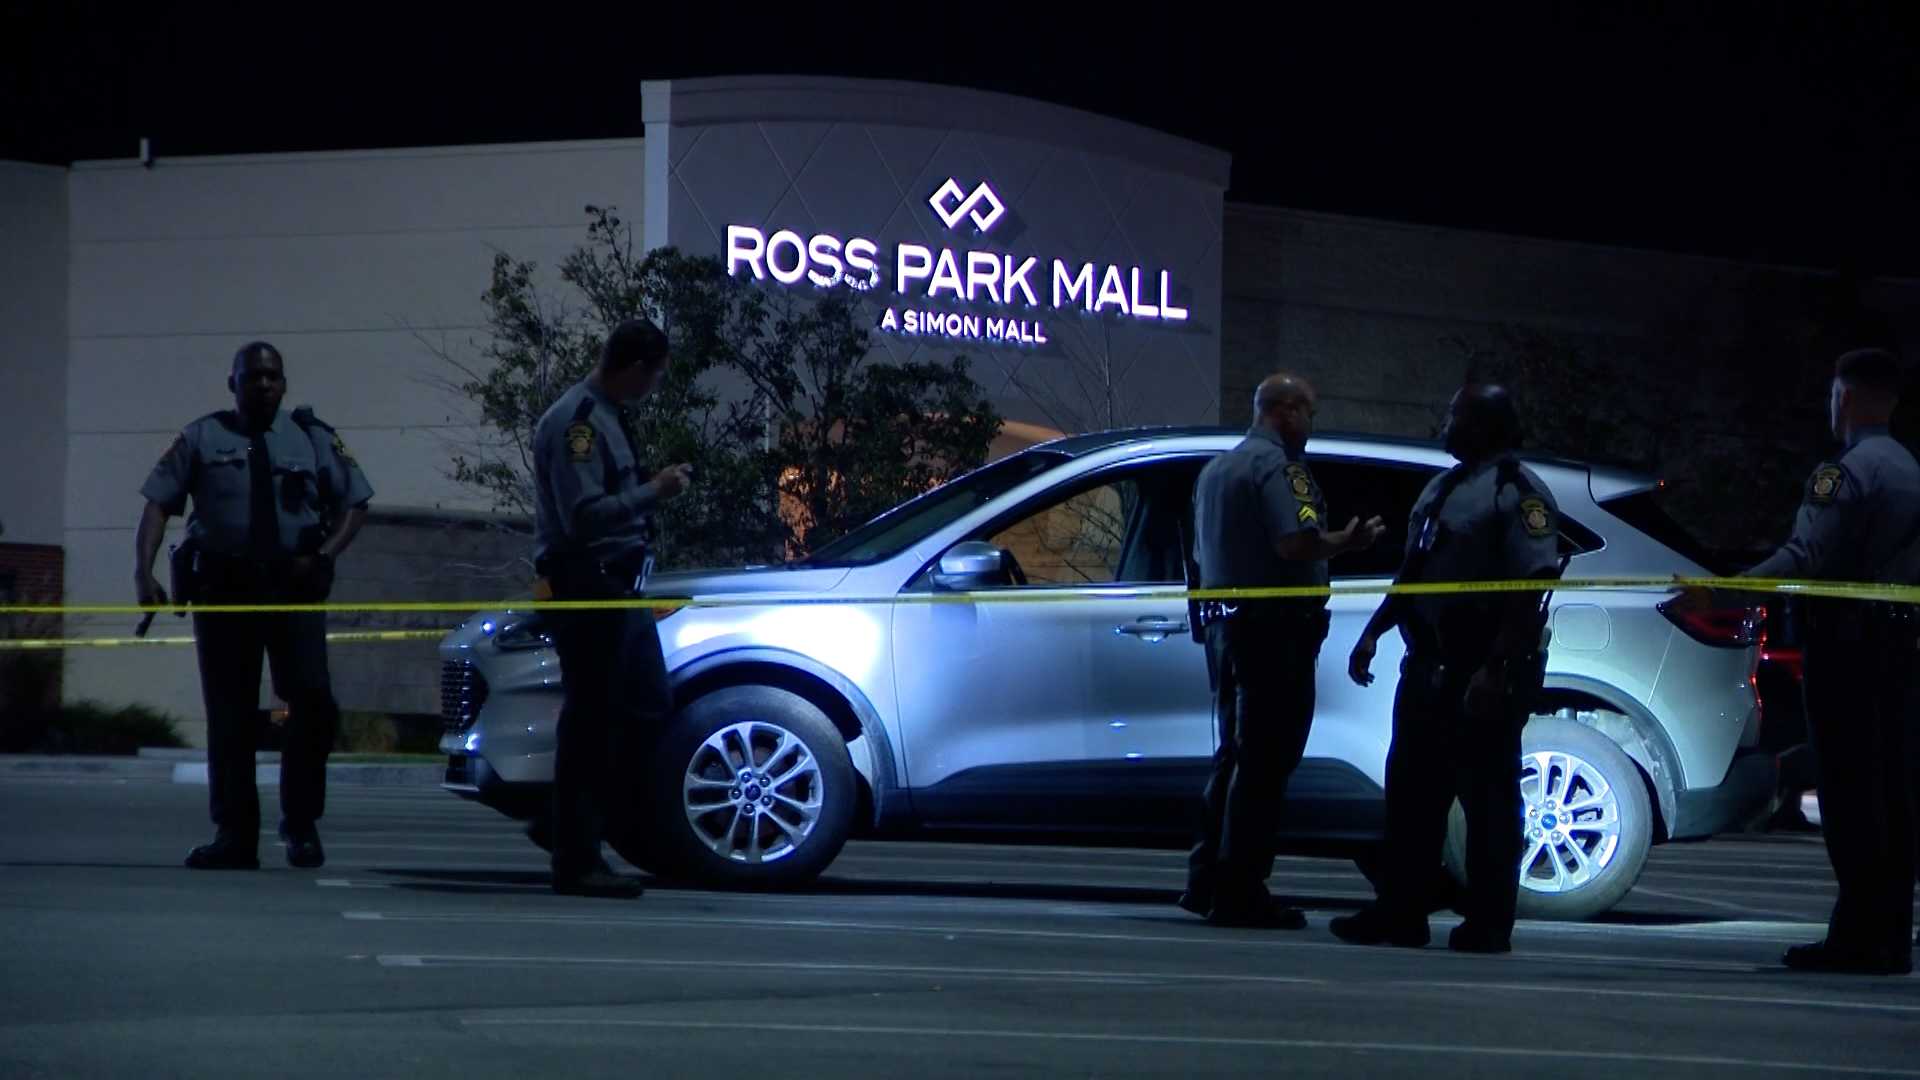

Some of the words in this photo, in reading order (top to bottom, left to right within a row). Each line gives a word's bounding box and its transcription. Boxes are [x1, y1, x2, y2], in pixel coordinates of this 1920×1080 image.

[727, 224, 880, 290] ROSS
[897, 244, 1038, 306] PARK
[1053, 259, 1188, 319] MALL
[881, 308, 897, 331] A
[903, 310, 980, 338] SIMON
[986, 317, 1047, 343] MALL
